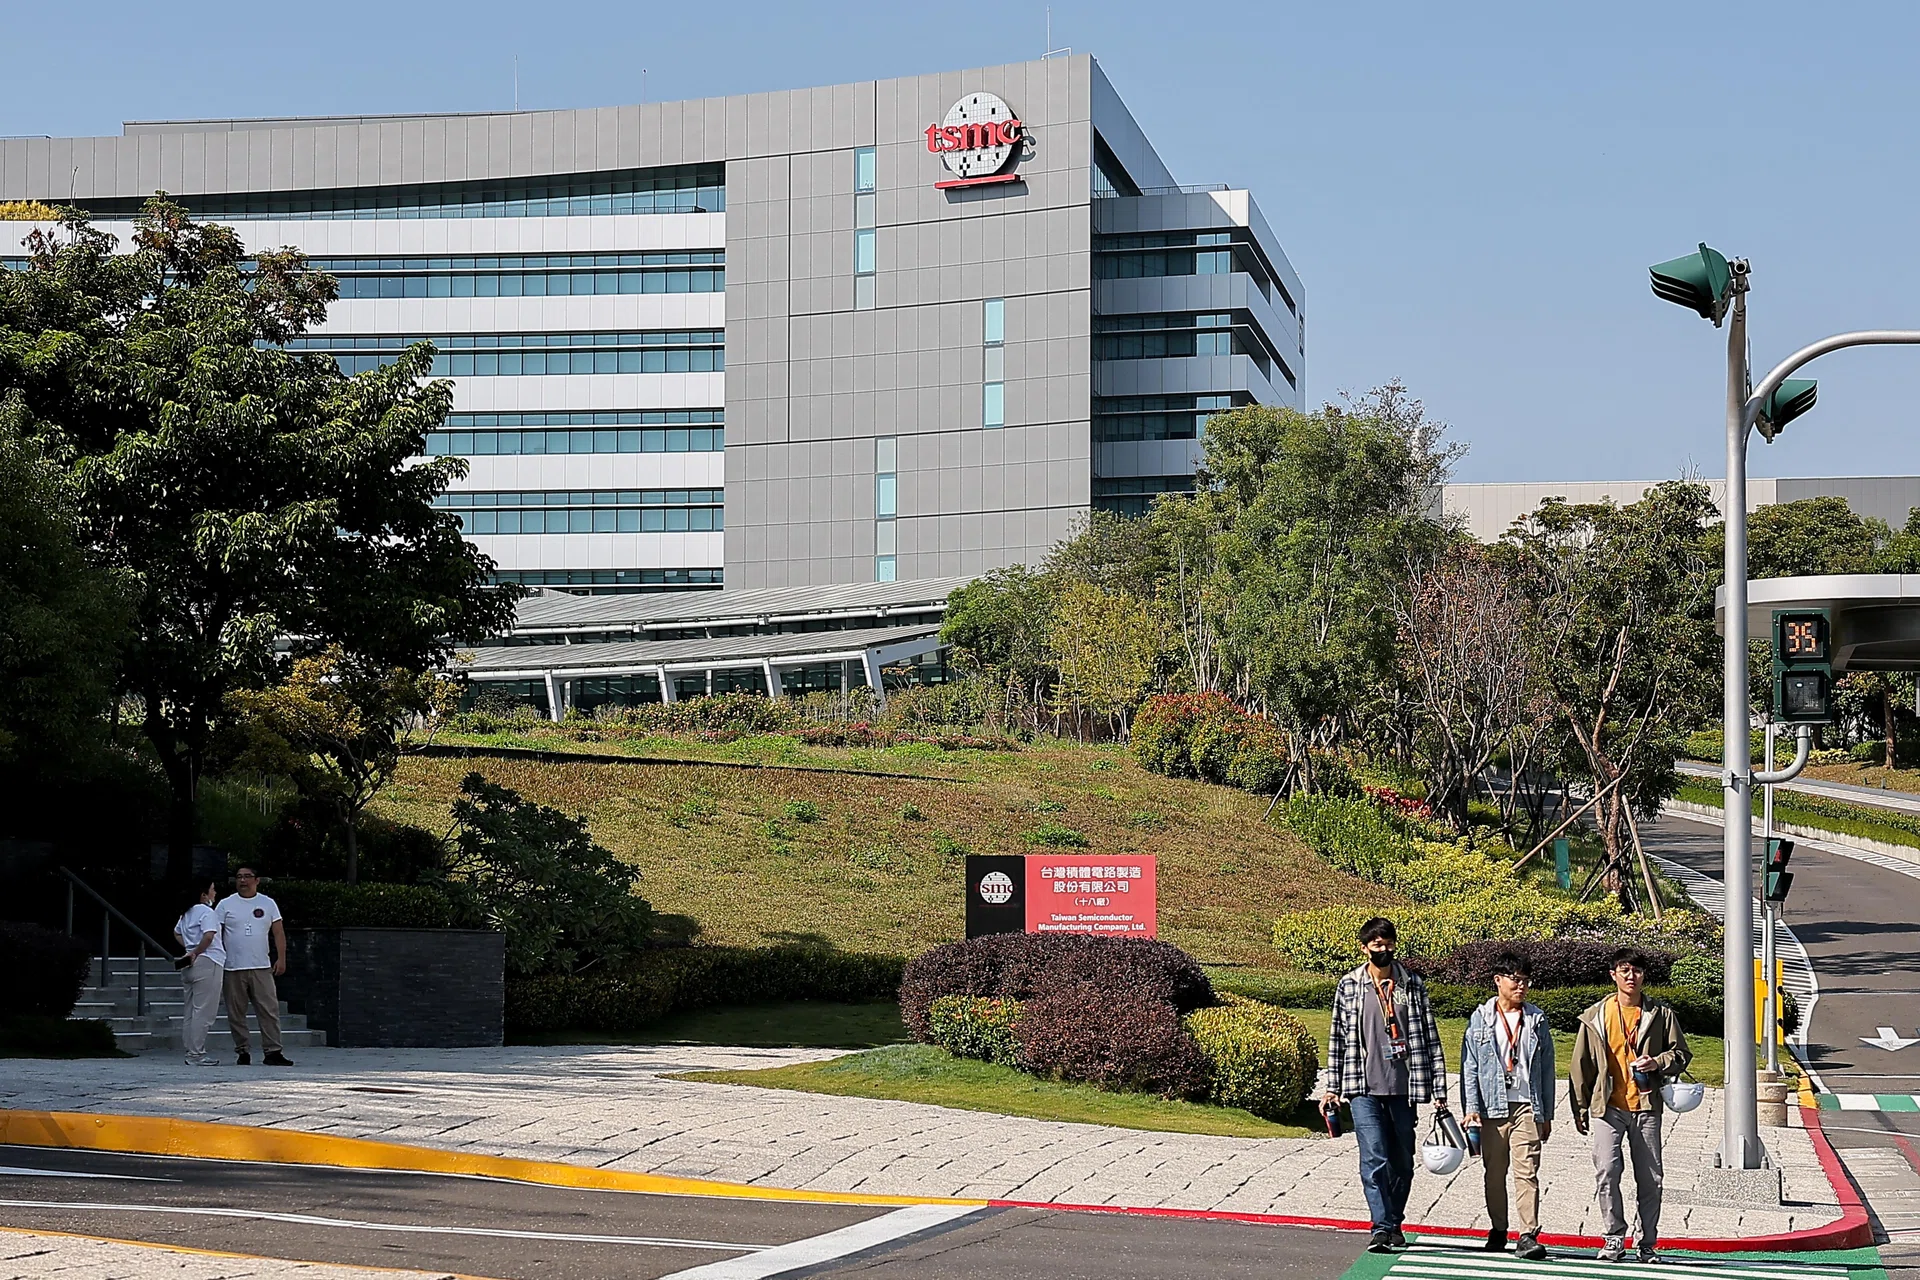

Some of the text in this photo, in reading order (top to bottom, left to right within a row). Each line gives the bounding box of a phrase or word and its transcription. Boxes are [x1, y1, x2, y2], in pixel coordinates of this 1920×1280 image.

[924, 119, 1021, 153] tsmc
[1788, 622, 1816, 652] 35
[1040, 866, 1142, 879] 台灣積體電路製造
[1053, 881, 1129, 893] 股份有限公司
[1038, 923, 1146, 932] Manufacturing Company, Ltd.
